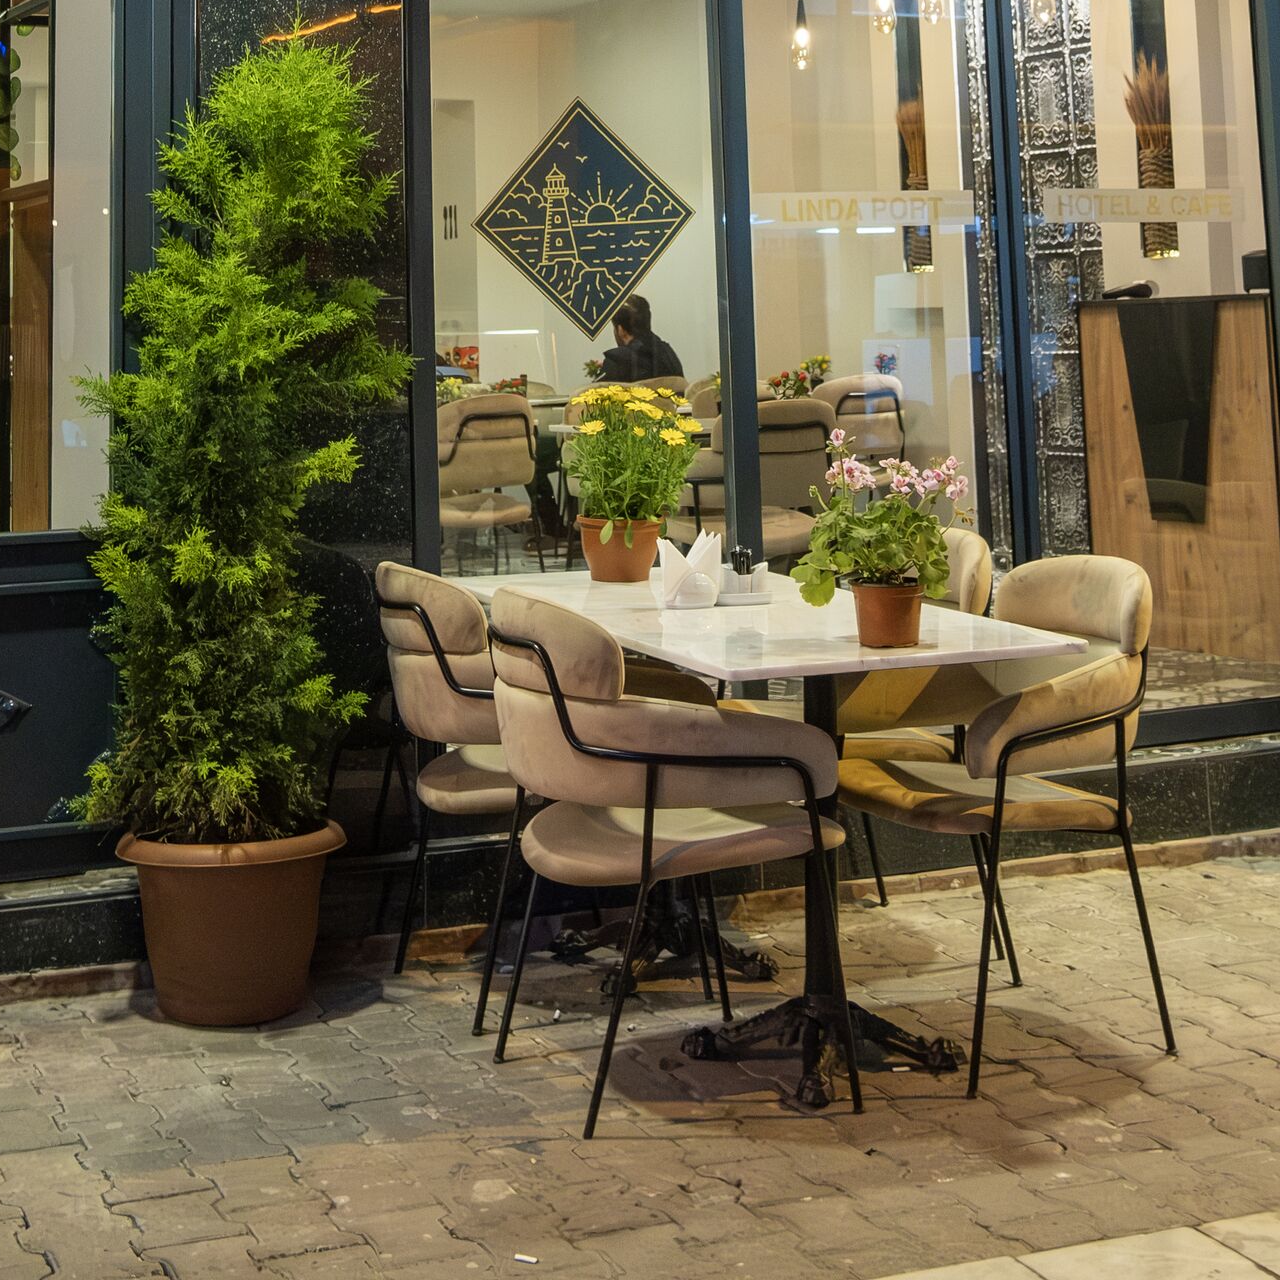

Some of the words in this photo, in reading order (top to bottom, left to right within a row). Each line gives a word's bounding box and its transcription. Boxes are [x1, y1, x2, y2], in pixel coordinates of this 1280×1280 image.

[780, 198, 862, 222] LINDA
[871, 197, 943, 222] PORT
[1057, 195, 1139, 217] HOTEL
[1146, 195, 1163, 217] &
[1170, 194, 1233, 217] CAFE
